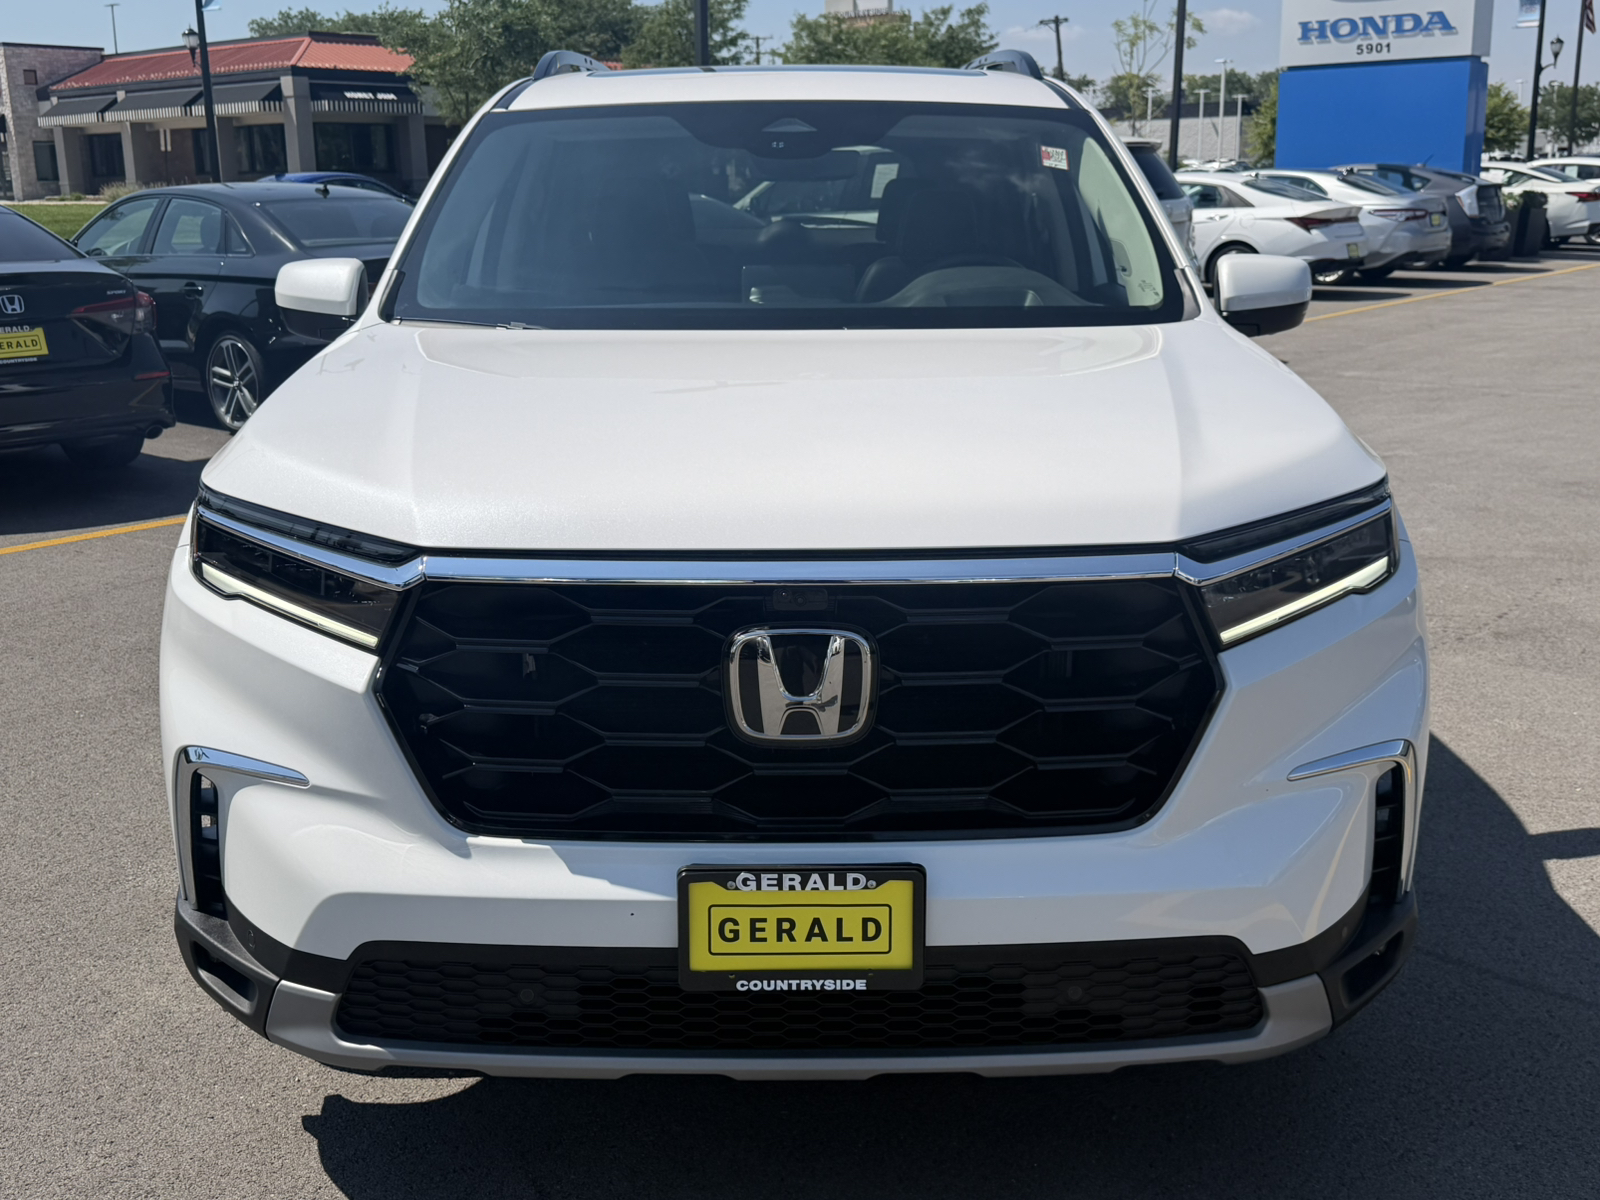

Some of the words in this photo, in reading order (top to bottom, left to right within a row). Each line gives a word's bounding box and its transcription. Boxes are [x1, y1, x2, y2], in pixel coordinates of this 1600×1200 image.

[1298, 11, 1458, 43] HONDA
[1356, 42, 1391, 55] 5901
[735, 872, 867, 891] GERALD
[718, 917, 882, 943] GERALD
[736, 979, 867, 991] COUNTRYSIDE
